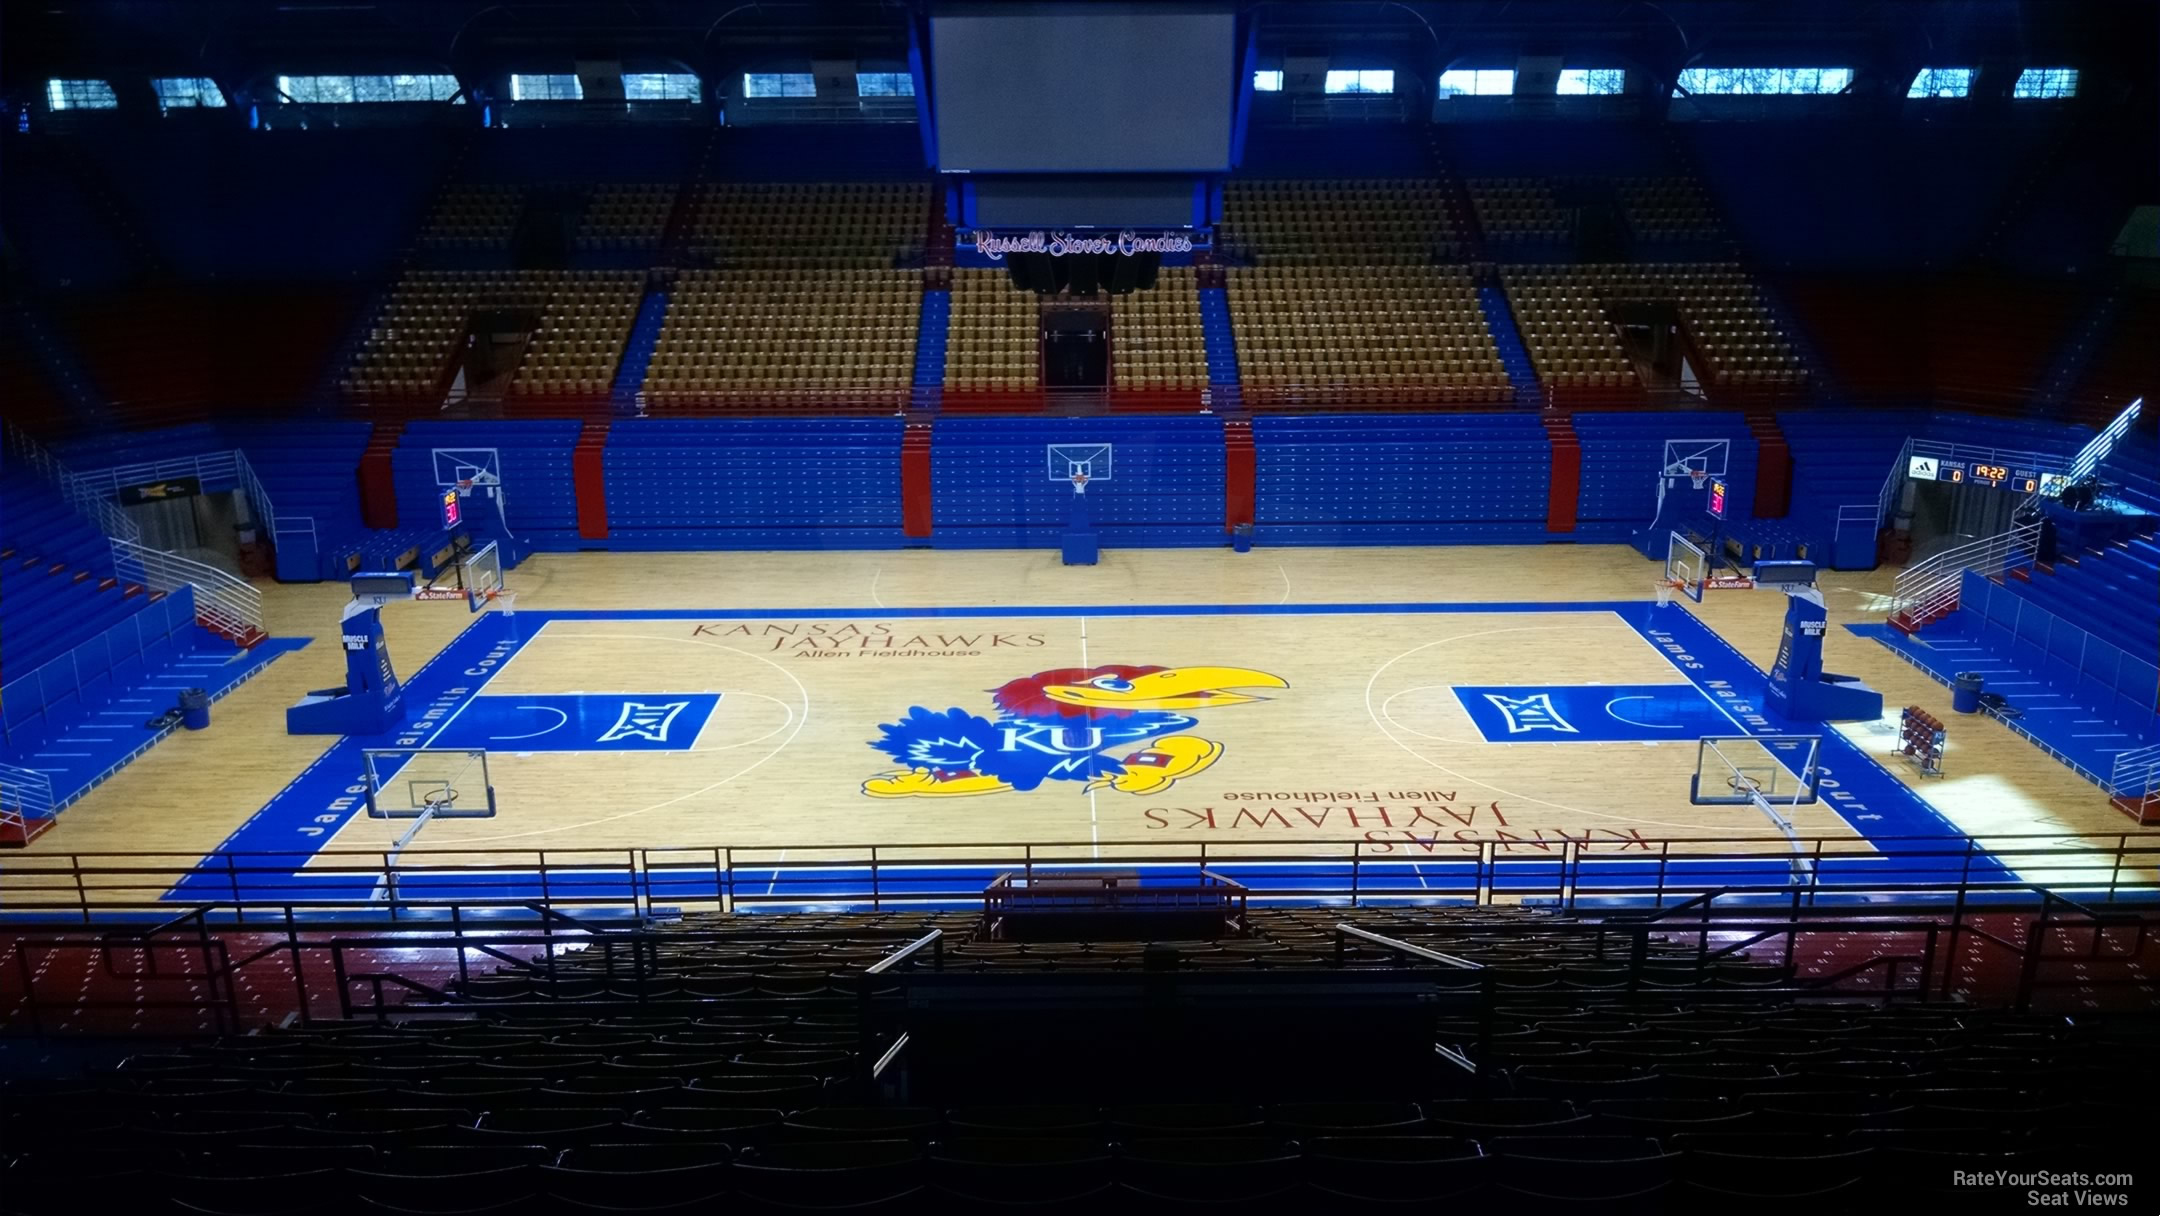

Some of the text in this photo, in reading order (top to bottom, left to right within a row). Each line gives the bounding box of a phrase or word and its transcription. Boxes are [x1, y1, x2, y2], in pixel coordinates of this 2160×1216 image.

[974, 228, 1192, 260] Russell Stover Candies
[1940, 459, 1965, 469] KANSAS
[1911, 469, 1935, 478] adidas
[1952, 470, 1961, 482] 0
[1976, 465, 2006, 480] 19:22
[2015, 469, 2037, 478] GUEST
[2025, 480, 2035, 492] 0
[1718, 581, 1750, 589] StateFarm
[428, 592, 463, 600] StateFarm
[692, 622, 894, 636] KANSAS
[1800, 620, 1826, 628] MUSCLE
[1804, 628, 1821, 636] MILK
[347, 642, 365, 650] MILK
[770, 634, 1046, 651] JAYHAWKS
[464, 639, 518, 676] Court
[793, 648, 981, 658] Allen Fieldhouse
[1648, 629, 1704, 670] James
[1704, 680, 1800, 750] Naismih
[996, 727, 1107, 755] KU
[1223, 790, 1457, 803] Allen Fieldhouse
[1144, 801, 1511, 829] JAYHAWKS
[1364, 828, 1654, 853] KANSAS
